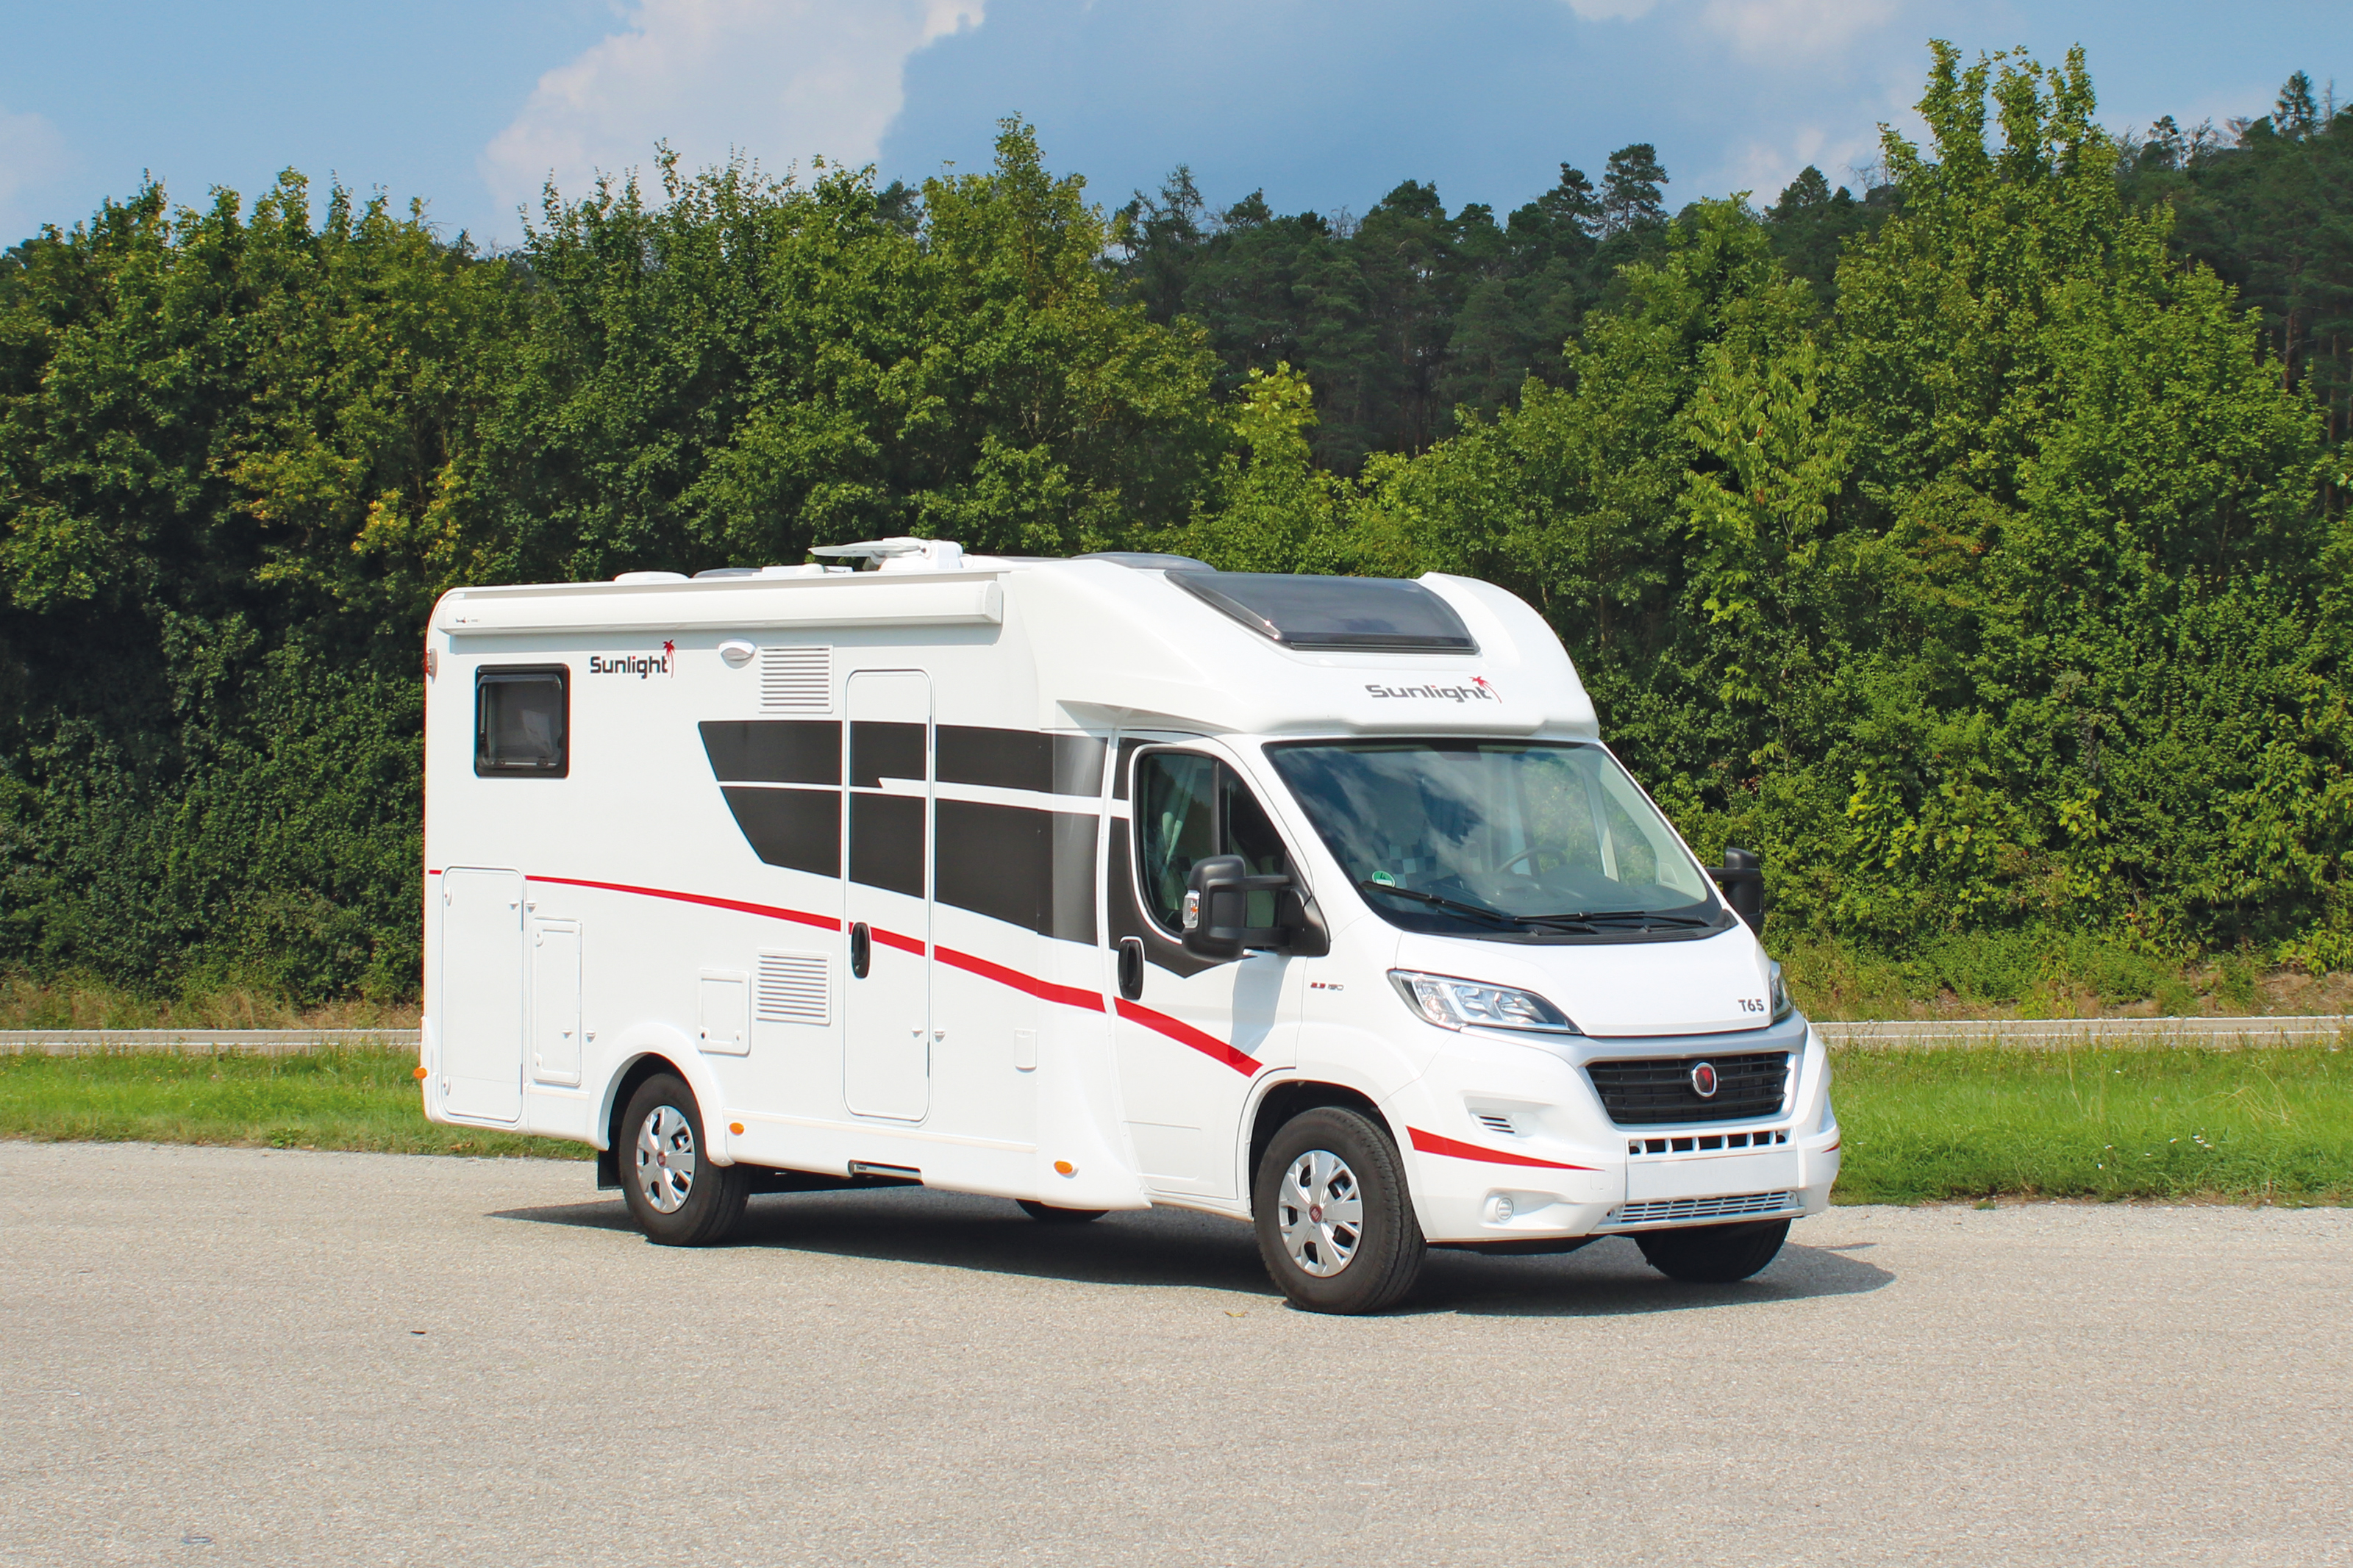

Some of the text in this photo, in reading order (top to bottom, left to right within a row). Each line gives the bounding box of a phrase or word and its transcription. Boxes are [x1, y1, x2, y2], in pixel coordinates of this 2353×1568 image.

[590, 656, 668, 679] Sunlight
[1365, 684, 1493, 703] Sunlight
[1738, 999, 1764, 1012] T65
